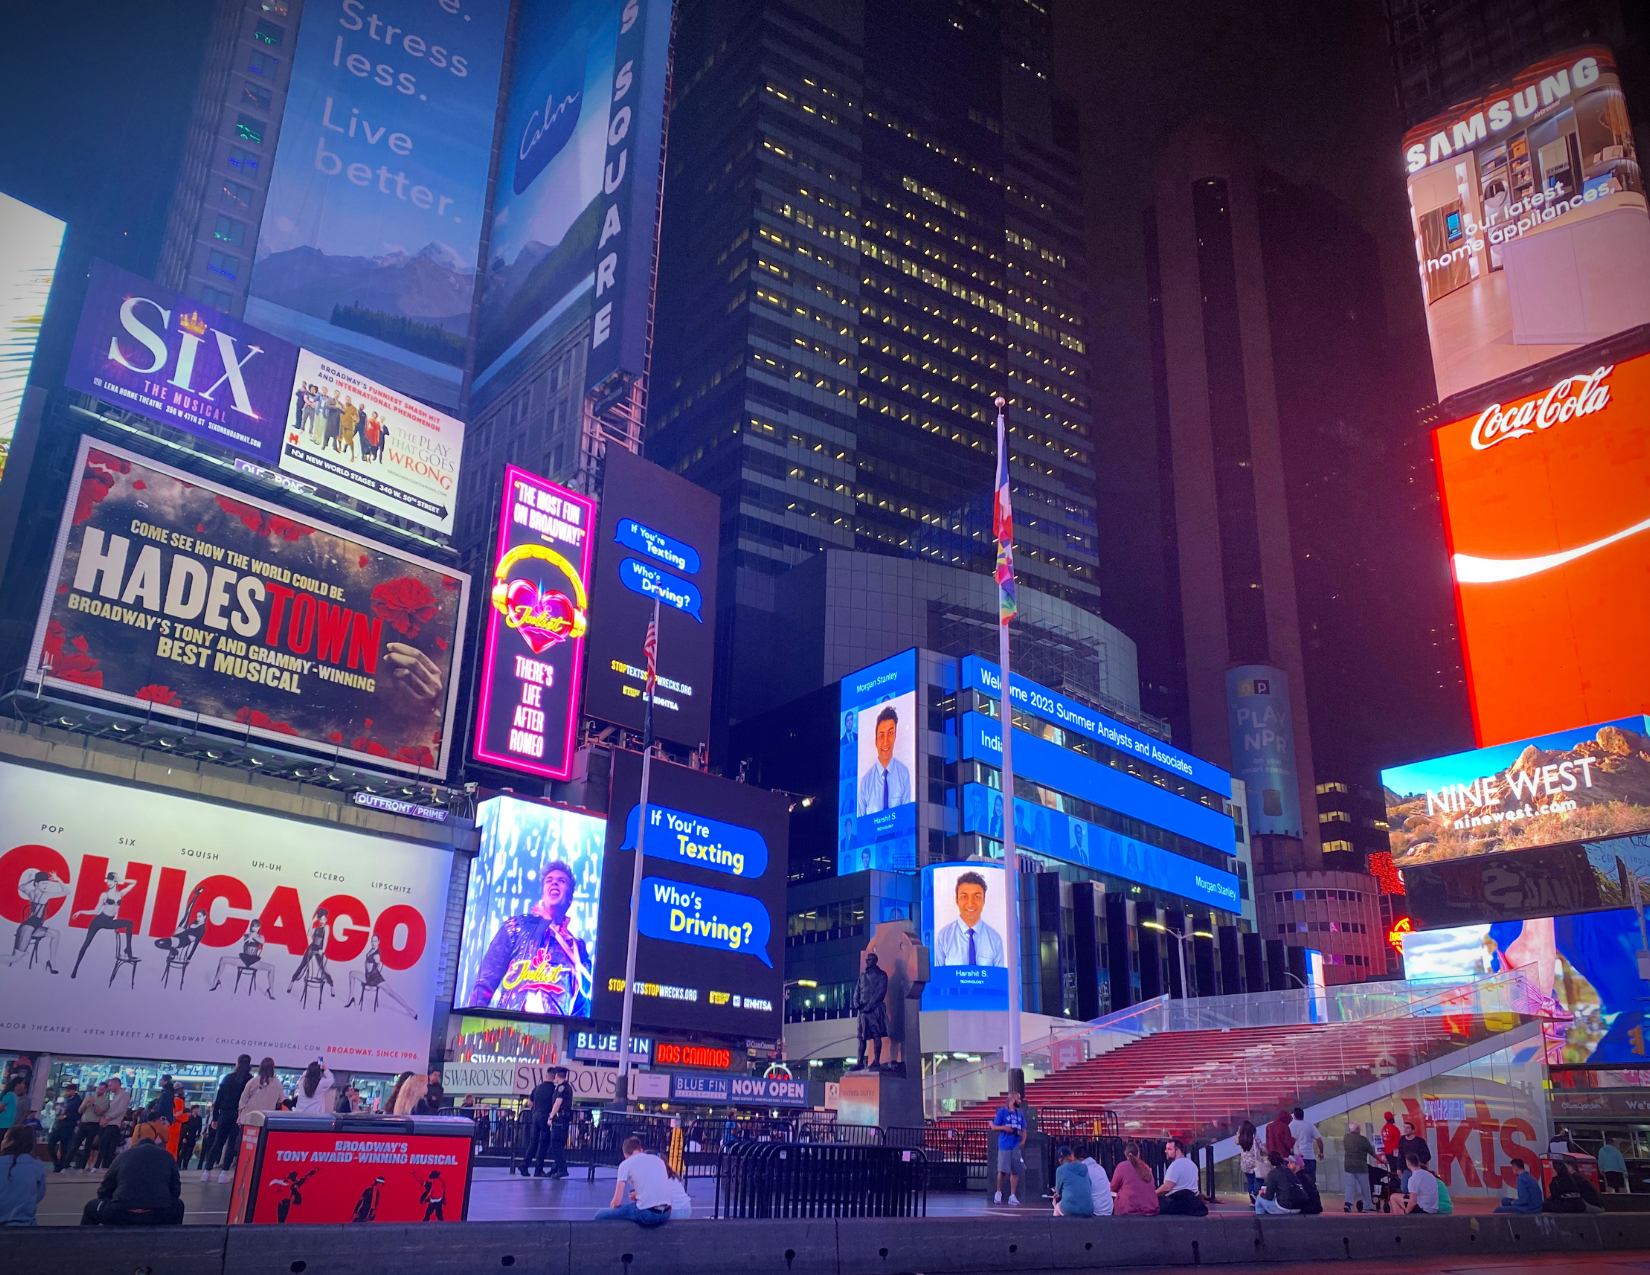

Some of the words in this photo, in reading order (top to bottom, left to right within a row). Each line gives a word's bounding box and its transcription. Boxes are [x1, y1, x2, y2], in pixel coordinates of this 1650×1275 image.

[338, 0, 470, 78] Stress
[333, 36, 428, 101] less.
[322, 97, 414, 156] Live
[519, 90, 581, 161] Calm
[1406, 56, 1600, 173] SAMSUNG
[315, 137, 462, 224] better.
[592, 60, 635, 349] SQUARE
[1464, 211, 1498, 236] our
[1503, 180, 1565, 219] latest
[1426, 238, 1485, 273] home
[107, 296, 264, 420] SIX
[104, 381, 119, 393] LENA
[119, 387, 138, 401] HORNE
[138, 394, 163, 410] THEATRE
[178, 409, 184, 418] W
[184, 412, 197, 424] 47TH
[198, 417, 205, 426] ST
[144, 380, 168, 400] THE
[173, 391, 227, 424] MUSICAL
[317, 371, 334, 383] AND
[335, 379, 392, 410] INTERNATIONAL
[393, 405, 441, 432] PHENOMENON
[320, 363, 367, 390] BROADWAY'S
[368, 386, 403, 406] FUNNIEST
[404, 400, 428, 418] SMASH
[428, 412, 441, 424] HIT
[1470, 364, 1614, 450] Coca-Cola
[390, 436, 415, 455] THAT
[418, 449, 455, 473] GOES
[397, 427, 417, 443] THE
[419, 434, 451, 457] PLAY
[305, 454, 324, 467] NEW
[324, 461, 350, 477] WORLD
[350, 472, 375, 488] STAGES
[379, 484, 393, 495] 340
[417, 500, 440, 514] STREET
[388, 447, 453, 491] WRONG
[513, 502, 529, 526] ON
[537, 490, 563, 517] MOST
[562, 500, 581, 525] FUN
[630, 523, 638, 535] If
[639, 527, 666, 547] You're
[130, 519, 170, 544] COME
[170, 532, 194, 552] SEE
[194, 540, 226, 561] HOW
[226, 549, 250, 570] THE
[251, 558, 292, 584] WORLD
[291, 571, 328, 596] COULD
[329, 587, 346, 602] BE.
[646, 540, 686, 570] Texting
[73, 526, 383, 675] HADESTOWN
[67, 593, 171, 635] BROADWAY'S
[216, 634, 246, 657] AND
[505, 605, 572, 633] Juliet
[156, 636, 211, 668] BEST
[213, 652, 301, 694] MUSICAL
[514, 654, 554, 687] THERE'S
[521, 682, 542, 708] LIFE
[856, 678, 877, 694] Morgan
[877, 670, 898, 687] Stanley
[513, 705, 545, 733] AFTER
[1030, 691, 1054, 714] 2023
[1056, 701, 1096, 733] Summer
[1097, 720, 1133, 749] Analysts
[1134, 737, 1150, 757] and
[1151, 745, 1193, 776] Associates
[508, 730, 544, 758] ROMEO
[1426, 776, 1501, 816] NINE
[1505, 756, 1596, 800] WEST
[358, 794, 413, 813] OUTFRONT
[417, 807, 445, 819] PRIME
[873, 814, 891, 825] Harshit
[891, 812, 898, 820] S.
[1453, 798, 1577, 830] ninewest.com
[40, 823, 65, 835] POP
[650, 809, 662, 826] If
[667, 813, 710, 838] You're
[118, 836, 137, 848] SIX
[180, 847, 220, 861] SQUISH
[677, 834, 745, 875] Texting
[251, 860, 283, 872] UH-UH
[313, 870, 346, 883] CICERO
[370, 880, 412, 895] LIPSCHITZ
[653, 883, 702, 910] Who's
[1195, 875, 1216, 894] Morgan
[1216, 882, 1237, 900] Stanley
[0, 844, 427, 971] CHICAGO
[670, 908, 753, 949] Driving?
[502, 958, 571, 990] Juliet
[955, 969, 980, 978] Harshit
[981, 970, 989, 978] S.
[31, 1024, 72, 1034] THEATRE
[83, 1028, 105, 1036] 49TH
[109, 1030, 142, 1038] STREET
[158, 1033, 206, 1043] BROADWAY
[215, 1037, 321, 1051] CHICAGOTHEMUSICAL.COM
[326, 1045, 374, 1056] BROADWAY.
[376, 1050, 399, 1059] SINCE
[400, 1051, 420, 1061] 1996.
[577, 1032, 618, 1051] BLUE
[657, 1043, 681, 1064] DOS
[682, 1046, 731, 1069] CAMINOS
[443, 1067, 513, 1087] SWAROVSKI
[516, 1066, 637, 1094] SWROVSI
[677, 1078, 704, 1090] BLUE
[708, 1080, 726, 1092] FIN
[731, 1079, 766, 1096] NOW
[769, 1081, 805, 1098] OPEN
[276, 1150, 309, 1162] TONY
[309, 1151, 408, 1165] AWARD-WINNING
[409, 1154, 458, 1166] MUSICAL
[335, 1140, 408, 1154] BROADWAY'S
